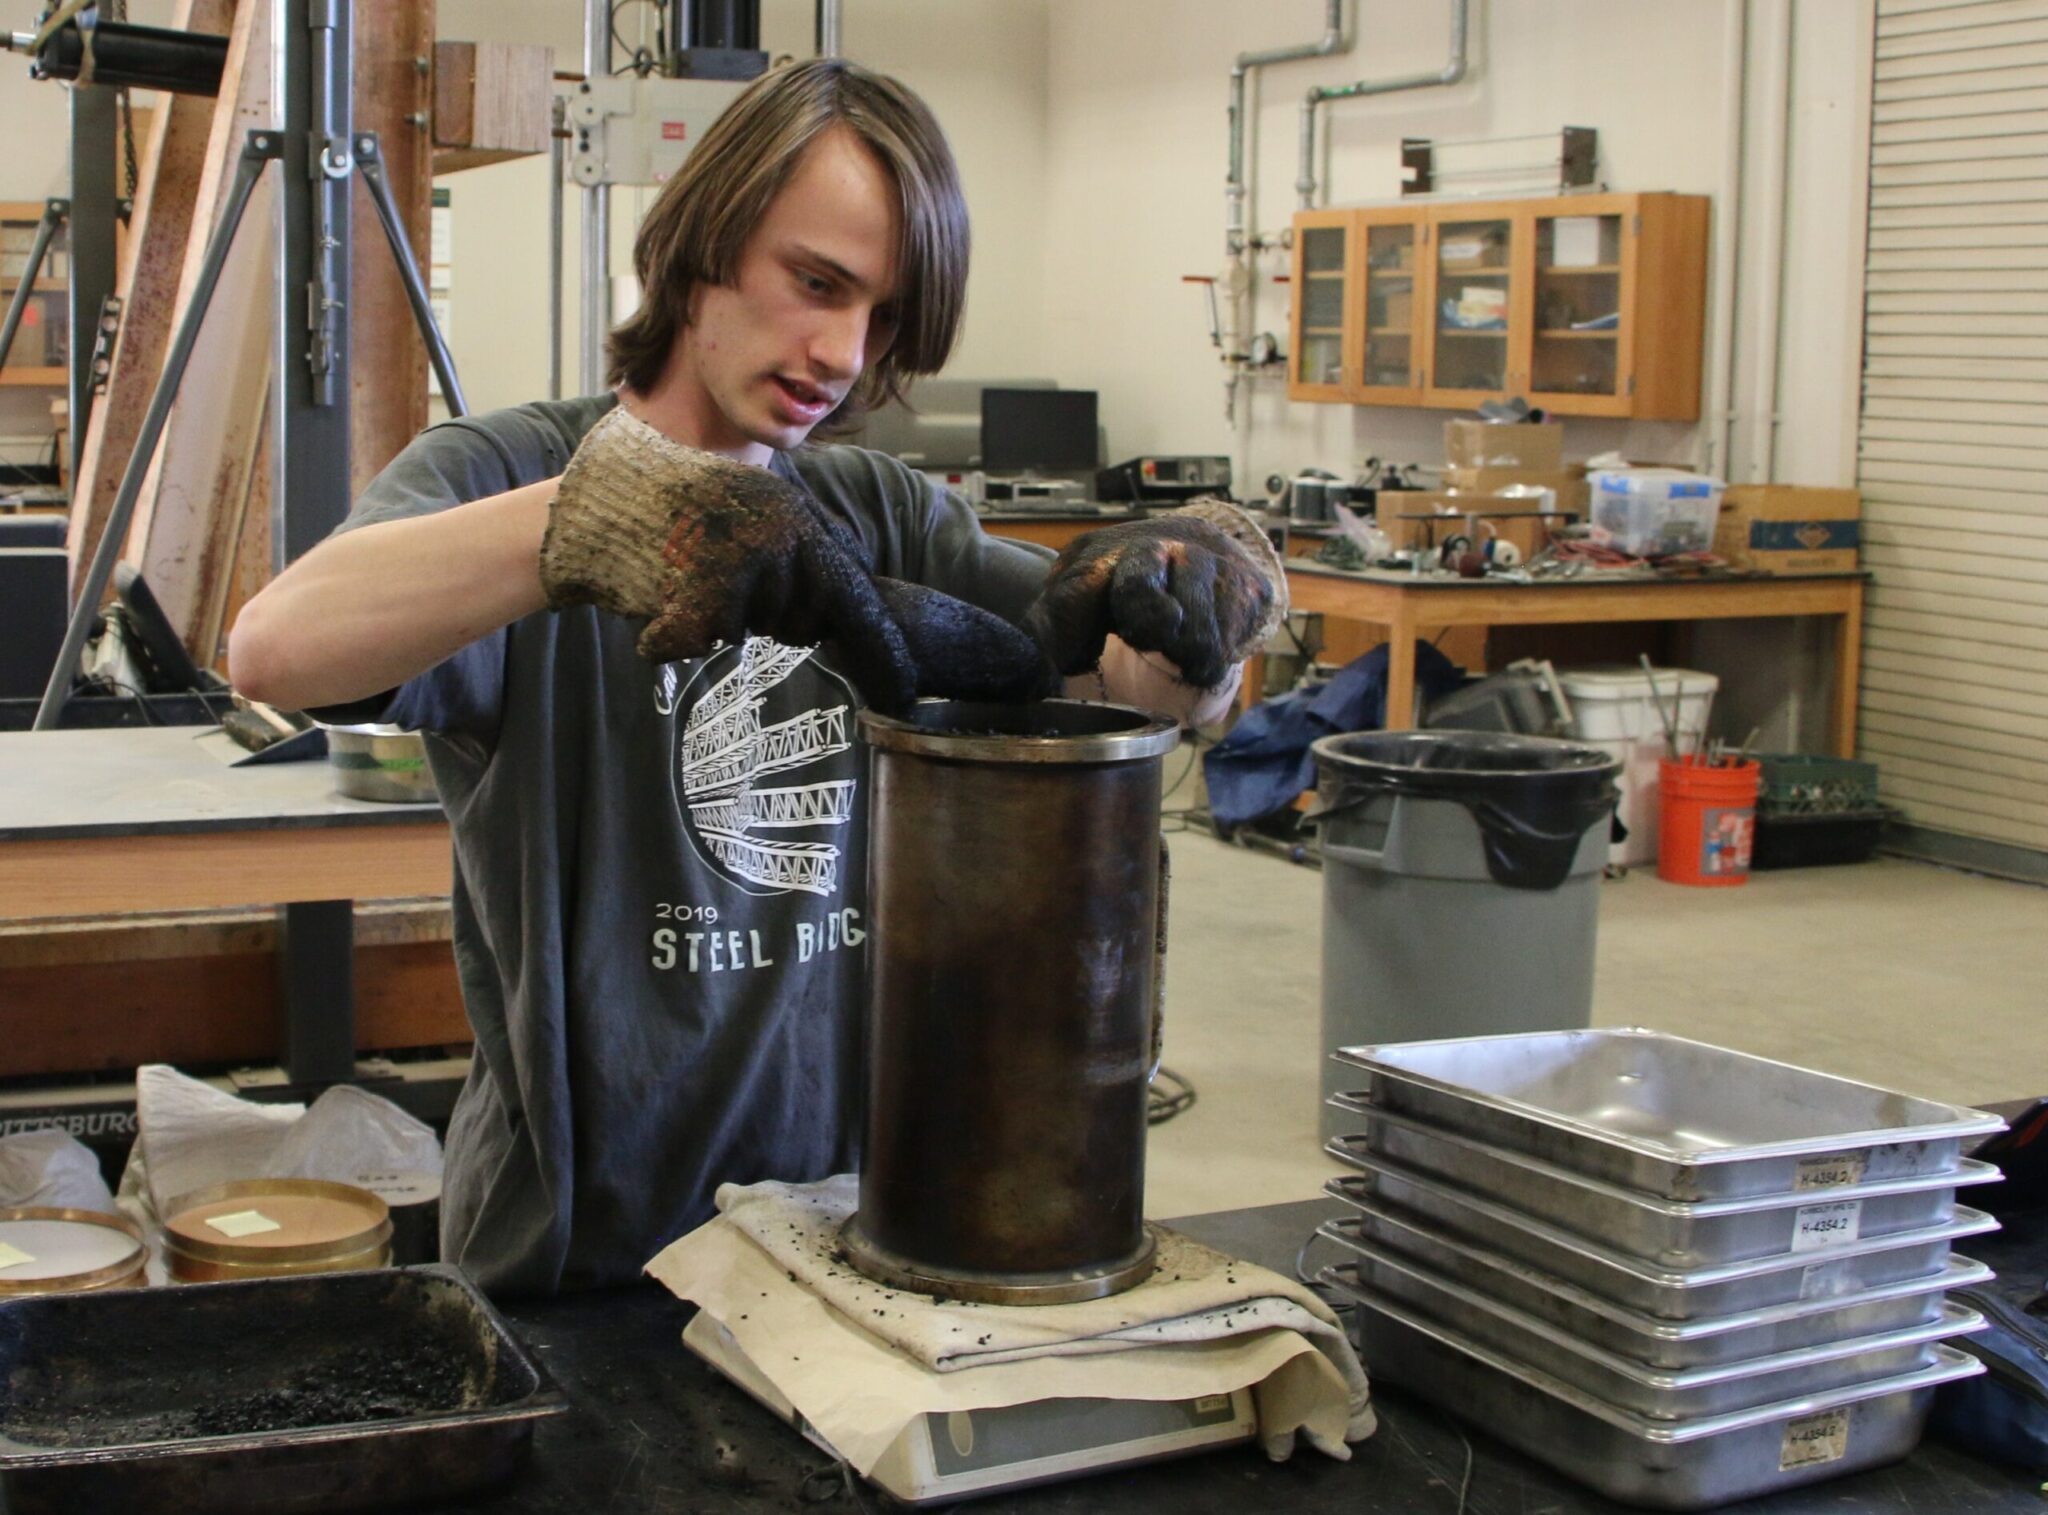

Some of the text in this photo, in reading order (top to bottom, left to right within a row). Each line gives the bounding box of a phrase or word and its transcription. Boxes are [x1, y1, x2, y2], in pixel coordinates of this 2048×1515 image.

[656, 903, 718, 925] 2019
[652, 928, 774, 973] STEEL
[1801, 1217, 1849, 1234] H-4354.2
